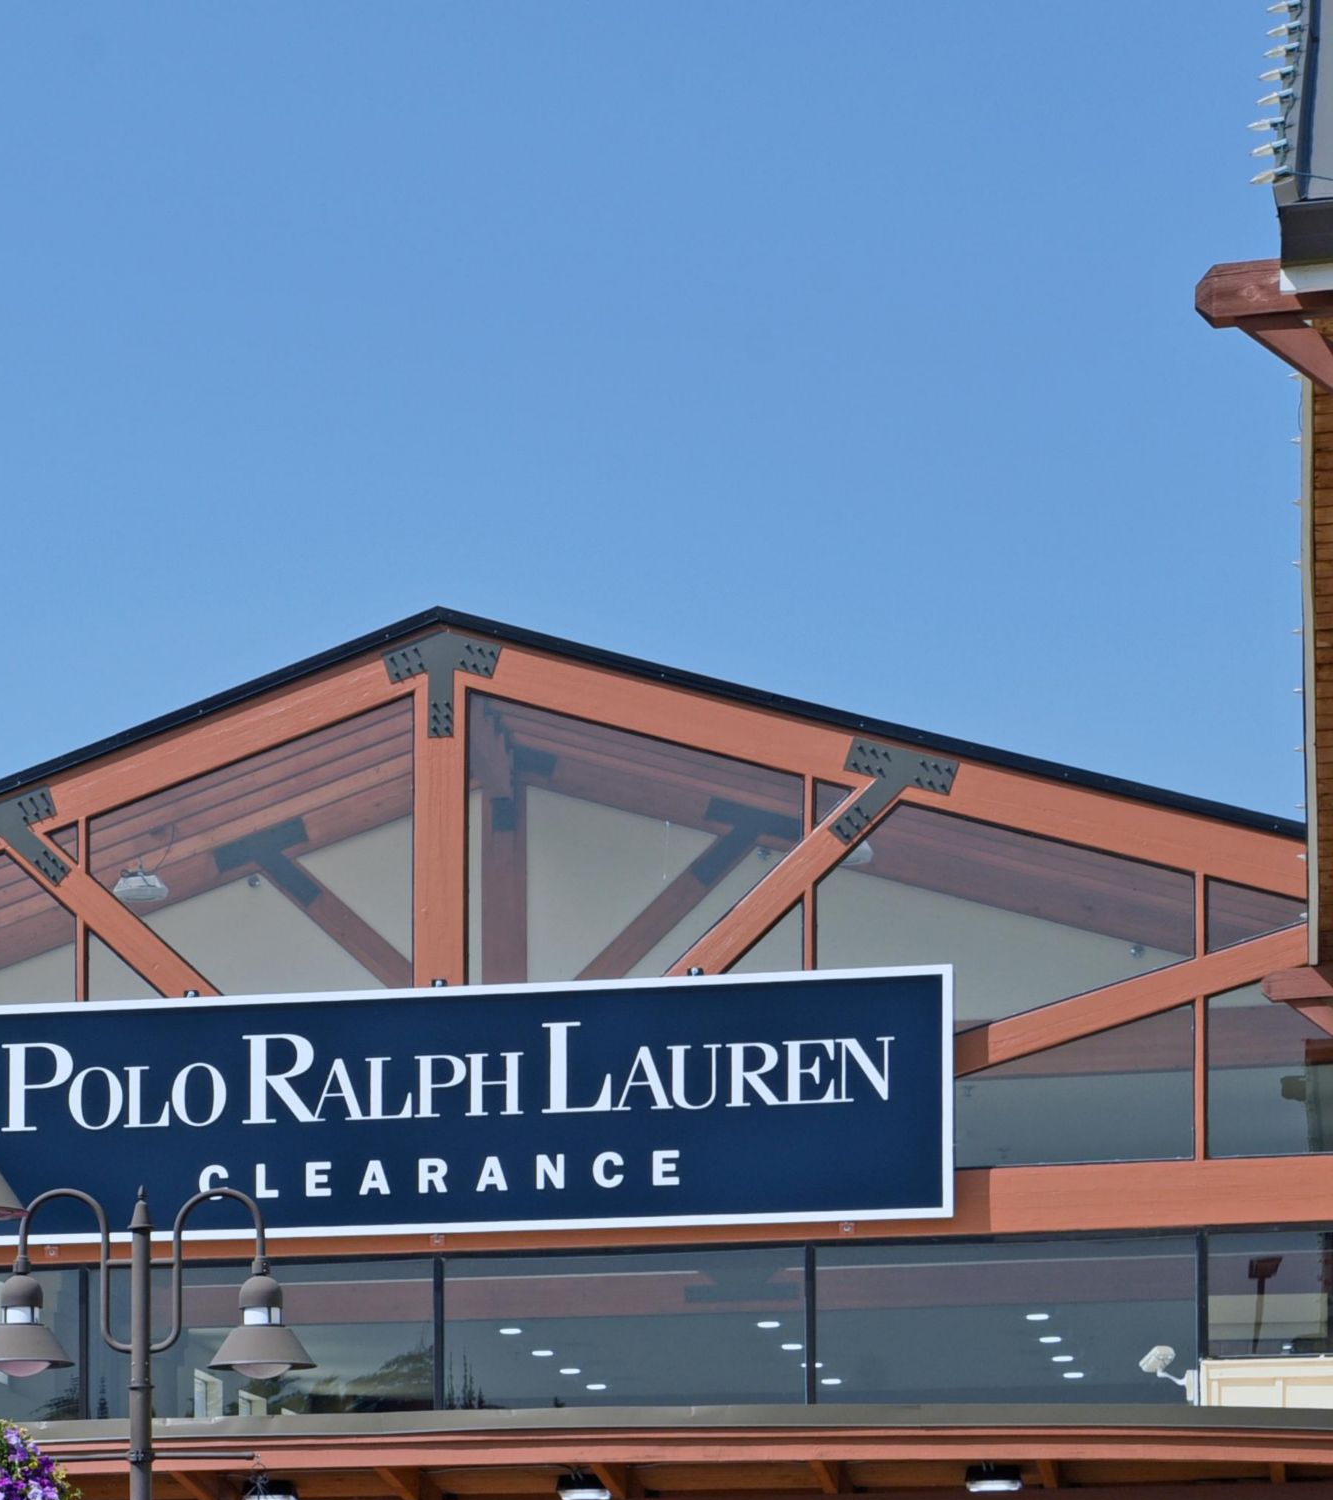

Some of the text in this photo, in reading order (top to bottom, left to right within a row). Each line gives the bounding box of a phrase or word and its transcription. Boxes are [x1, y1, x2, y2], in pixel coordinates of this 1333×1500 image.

[1, 1021, 895, 1132] POLO RALPH LAUREN
[198, 1149, 680, 1200] CLEARANCE
